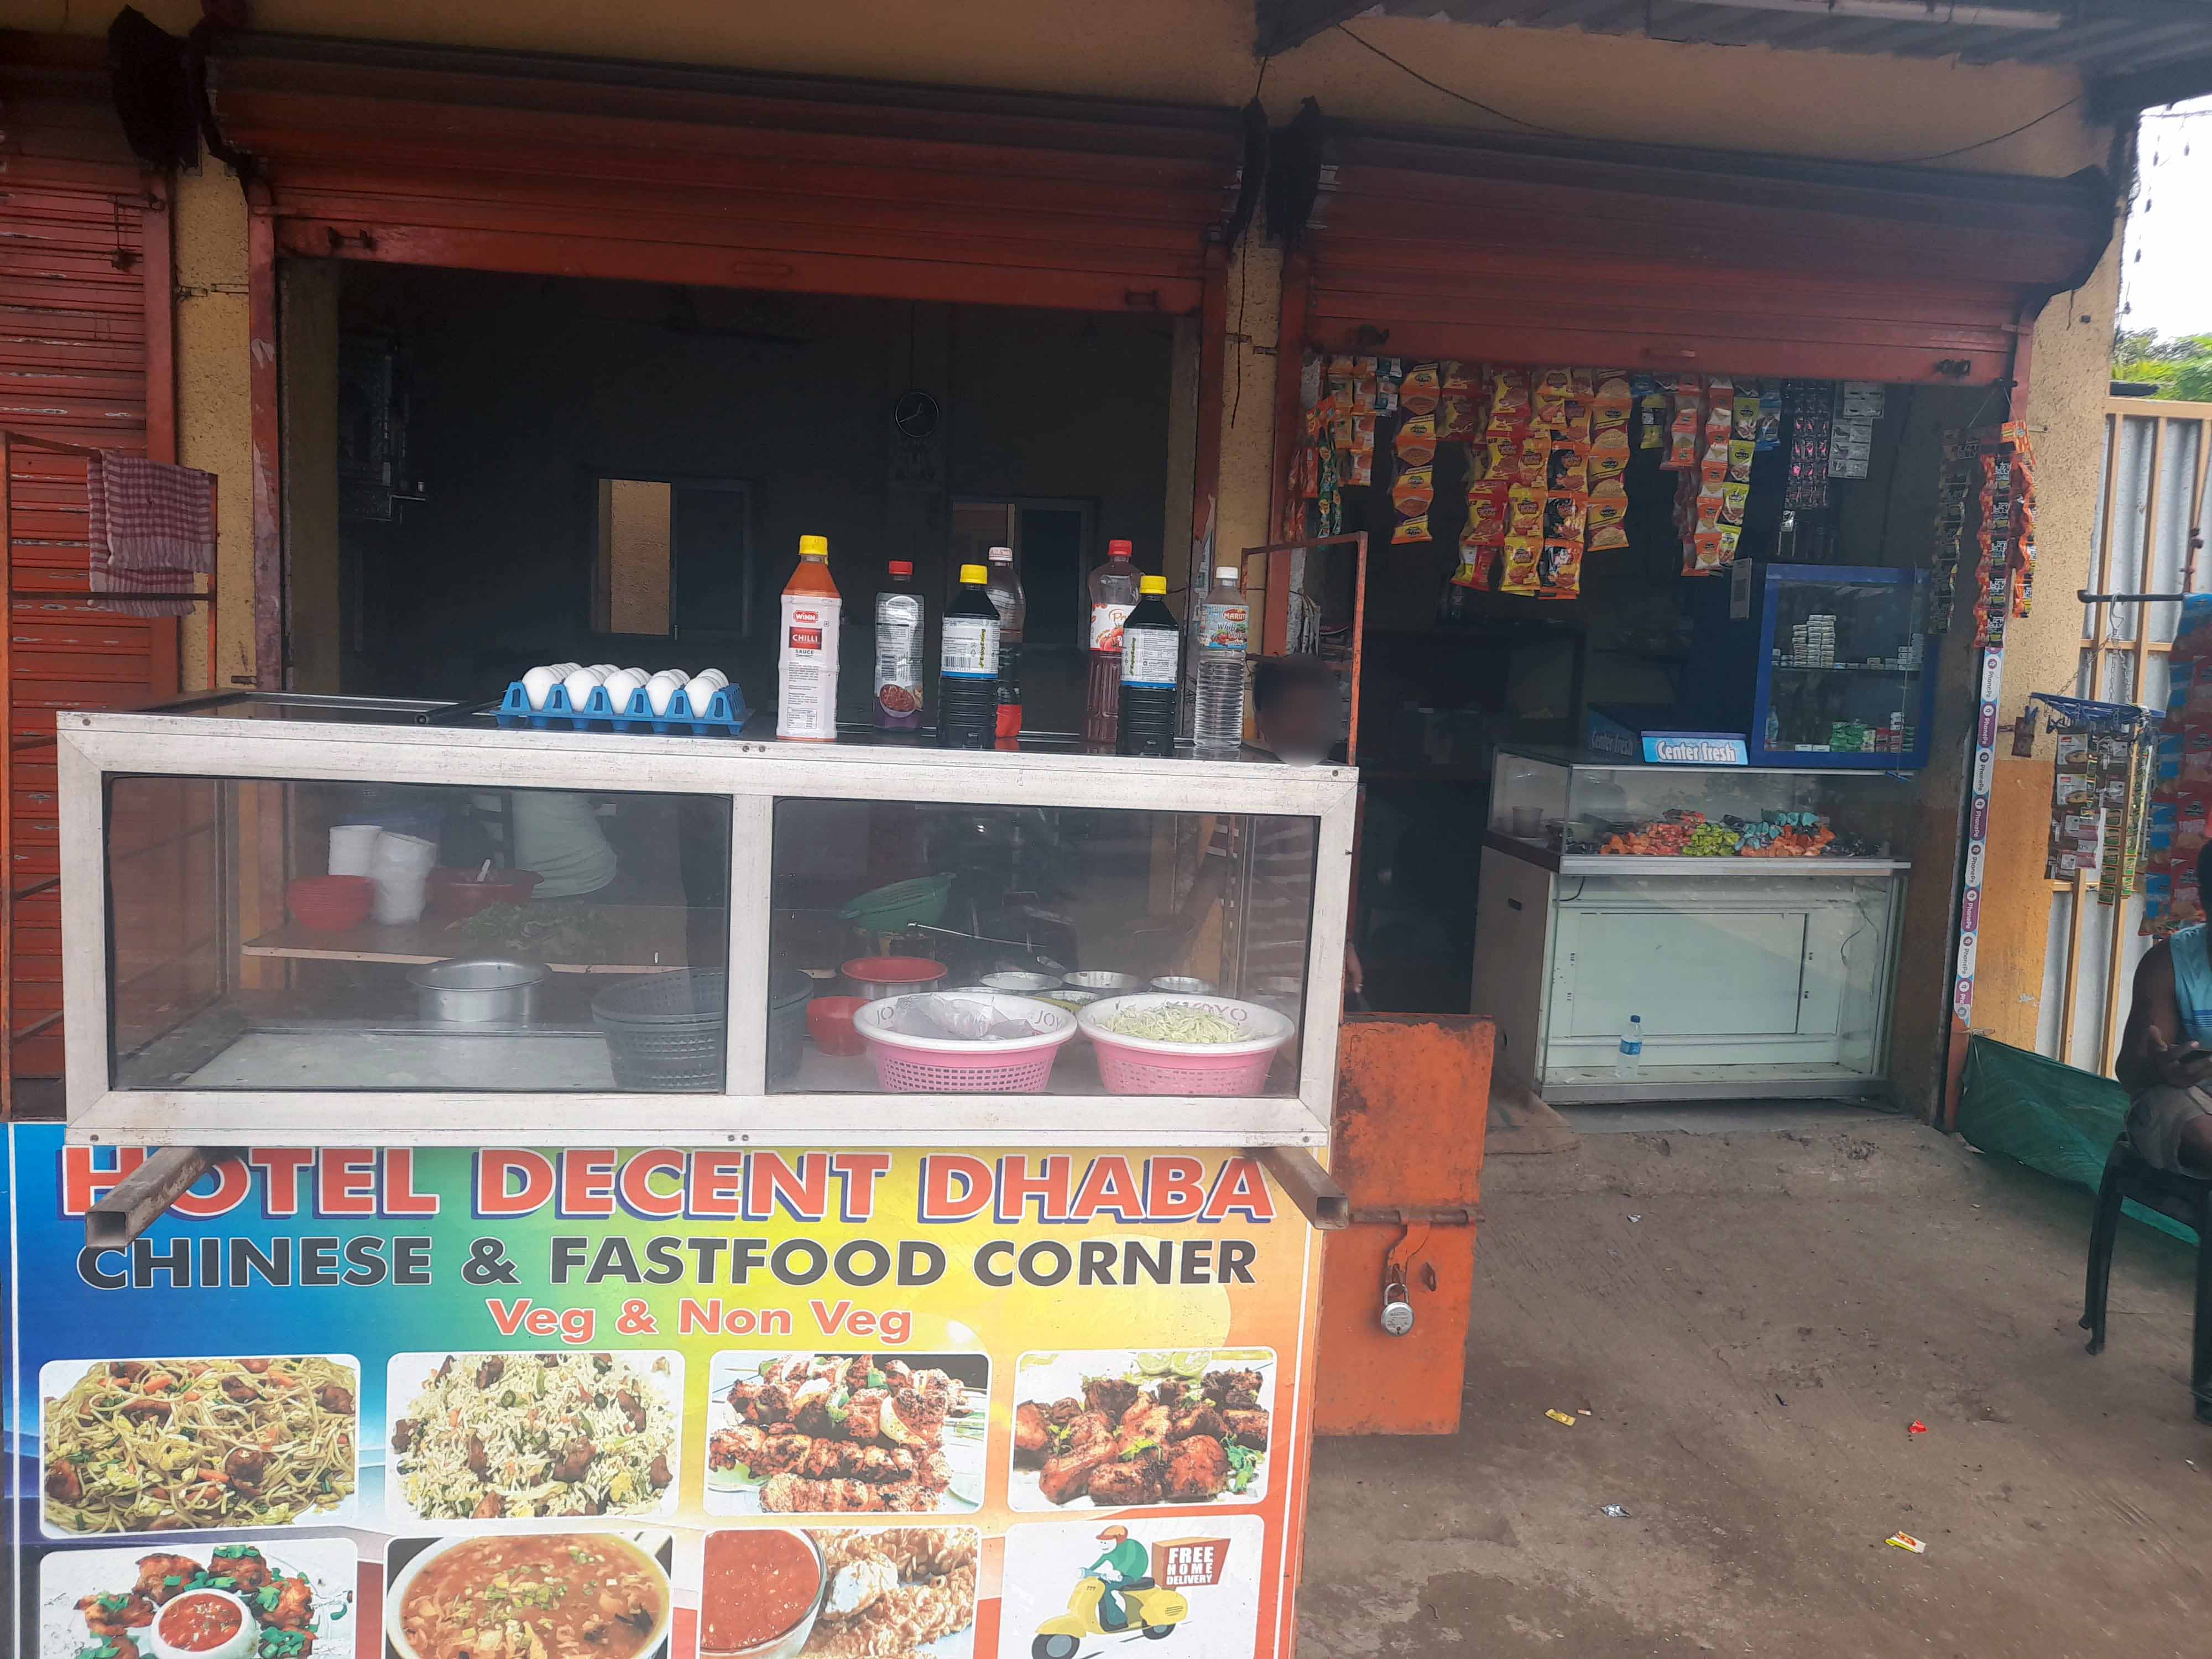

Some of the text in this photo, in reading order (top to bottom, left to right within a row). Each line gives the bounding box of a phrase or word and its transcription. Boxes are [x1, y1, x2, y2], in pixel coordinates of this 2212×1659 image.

[792, 634, 818, 642] CHILLI
[1986, 671, 1994, 698] PhonePe
[1982, 718, 1990, 745] PhonePe
[1657, 740, 1735, 762] Center fresh
[1965, 902, 1974, 930] PhonePe
[59, 1146, 1277, 1222] HOTEL DECENT DHABA
[77, 1235, 1257, 1289] CHINESE & FASTFOOD CORNER
[486, 1297, 912, 1344] Veg & Non Veg
[1168, 1546, 1214, 1564] FREE
[1166, 1574, 1213, 1585] DELIVERY
[1167, 1563, 1213, 1575] HOME
